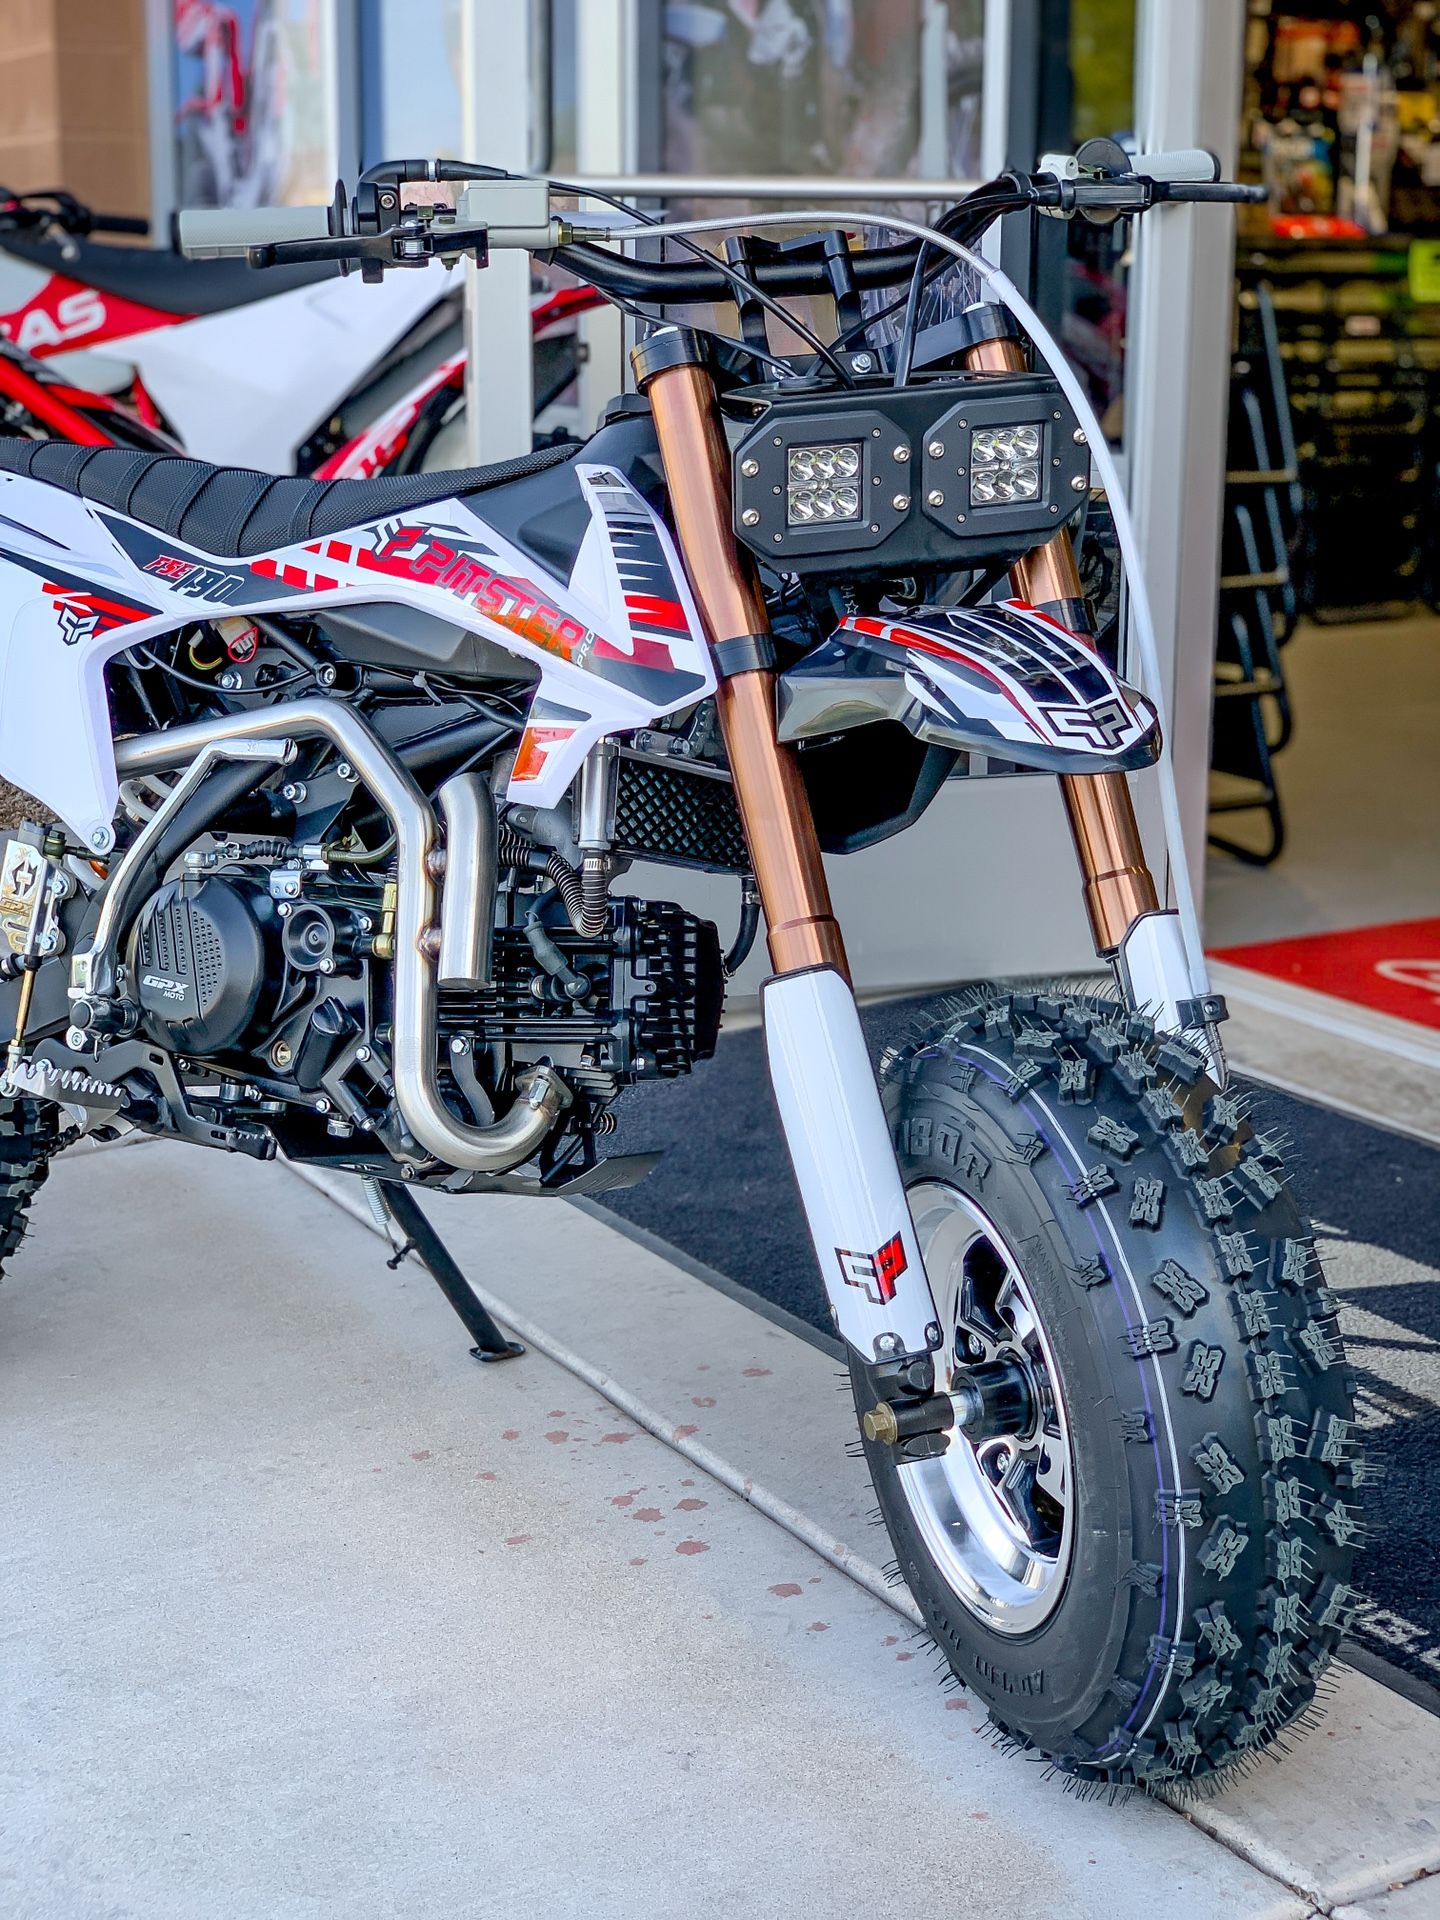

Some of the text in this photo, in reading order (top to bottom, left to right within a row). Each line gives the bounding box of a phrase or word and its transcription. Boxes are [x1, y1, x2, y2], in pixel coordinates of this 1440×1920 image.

[0, 288, 106, 351] AS
[410, 538, 588, 665] PITSTER
[576, 629, 597, 668] PRO
[142, 974, 190, 995] GPX
[162, 990, 186, 1002] MOTO
